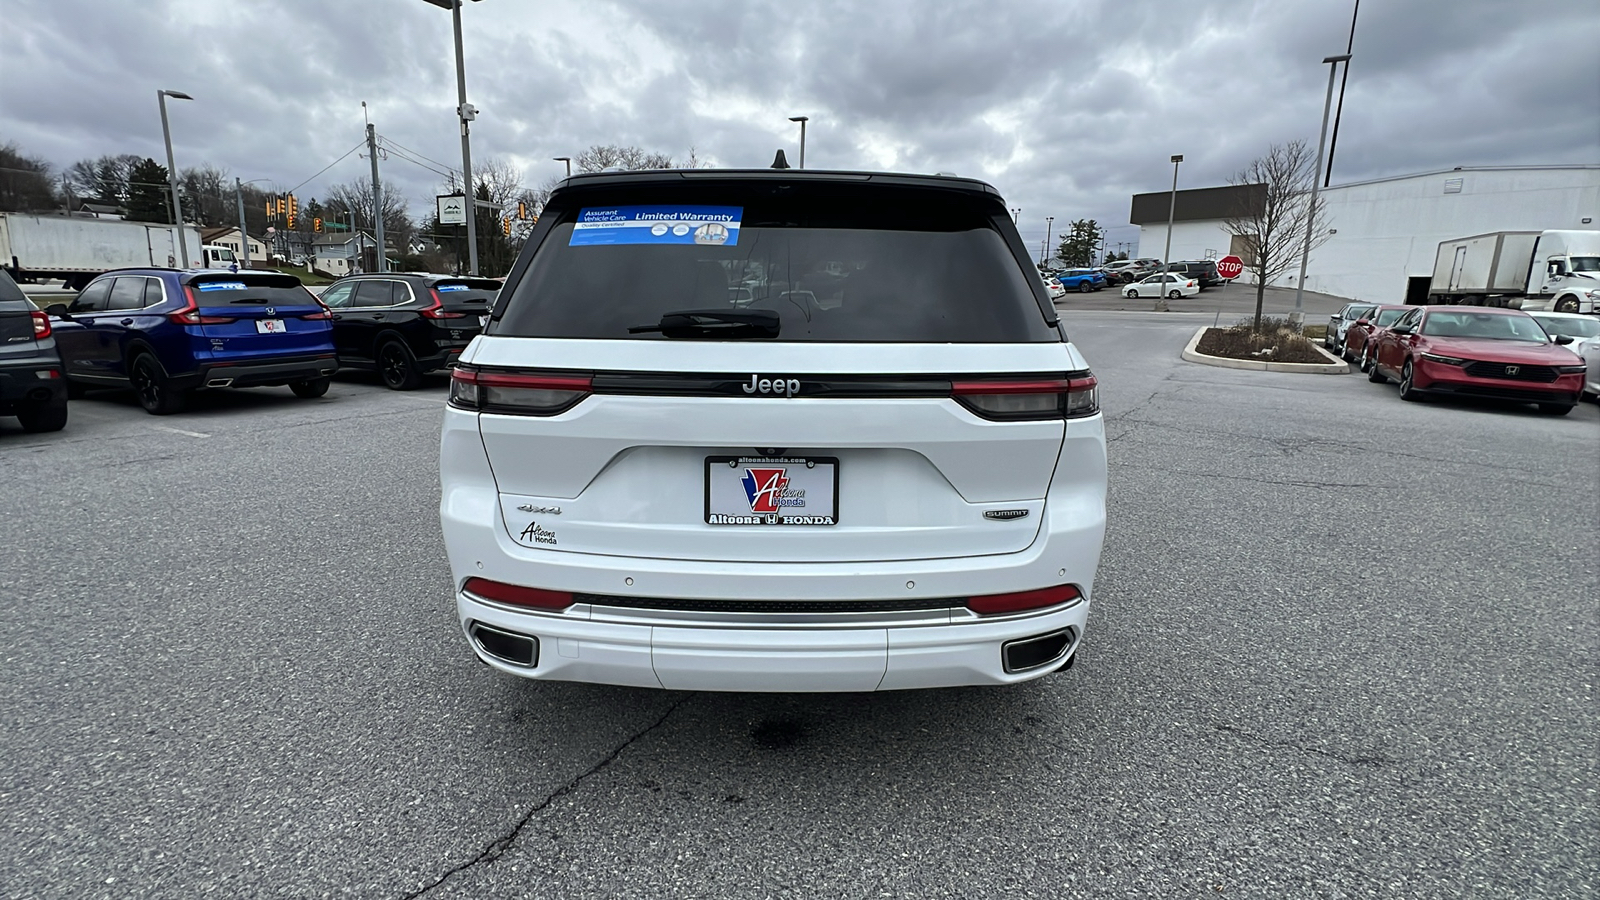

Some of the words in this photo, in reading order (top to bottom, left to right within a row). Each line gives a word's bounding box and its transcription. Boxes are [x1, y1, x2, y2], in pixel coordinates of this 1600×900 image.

[635, 213, 678, 221] Limited
[679, 213, 734, 222] Warranty
[1218, 262, 1242, 272] STOP
[742, 374, 801, 398] Jeep
[773, 498, 804, 506] Honda
[708, 514, 761, 525] Altoona
[782, 516, 834, 525] HONDA
[520, 521, 556, 542] Altoona
[534, 536, 557, 545] Honda
